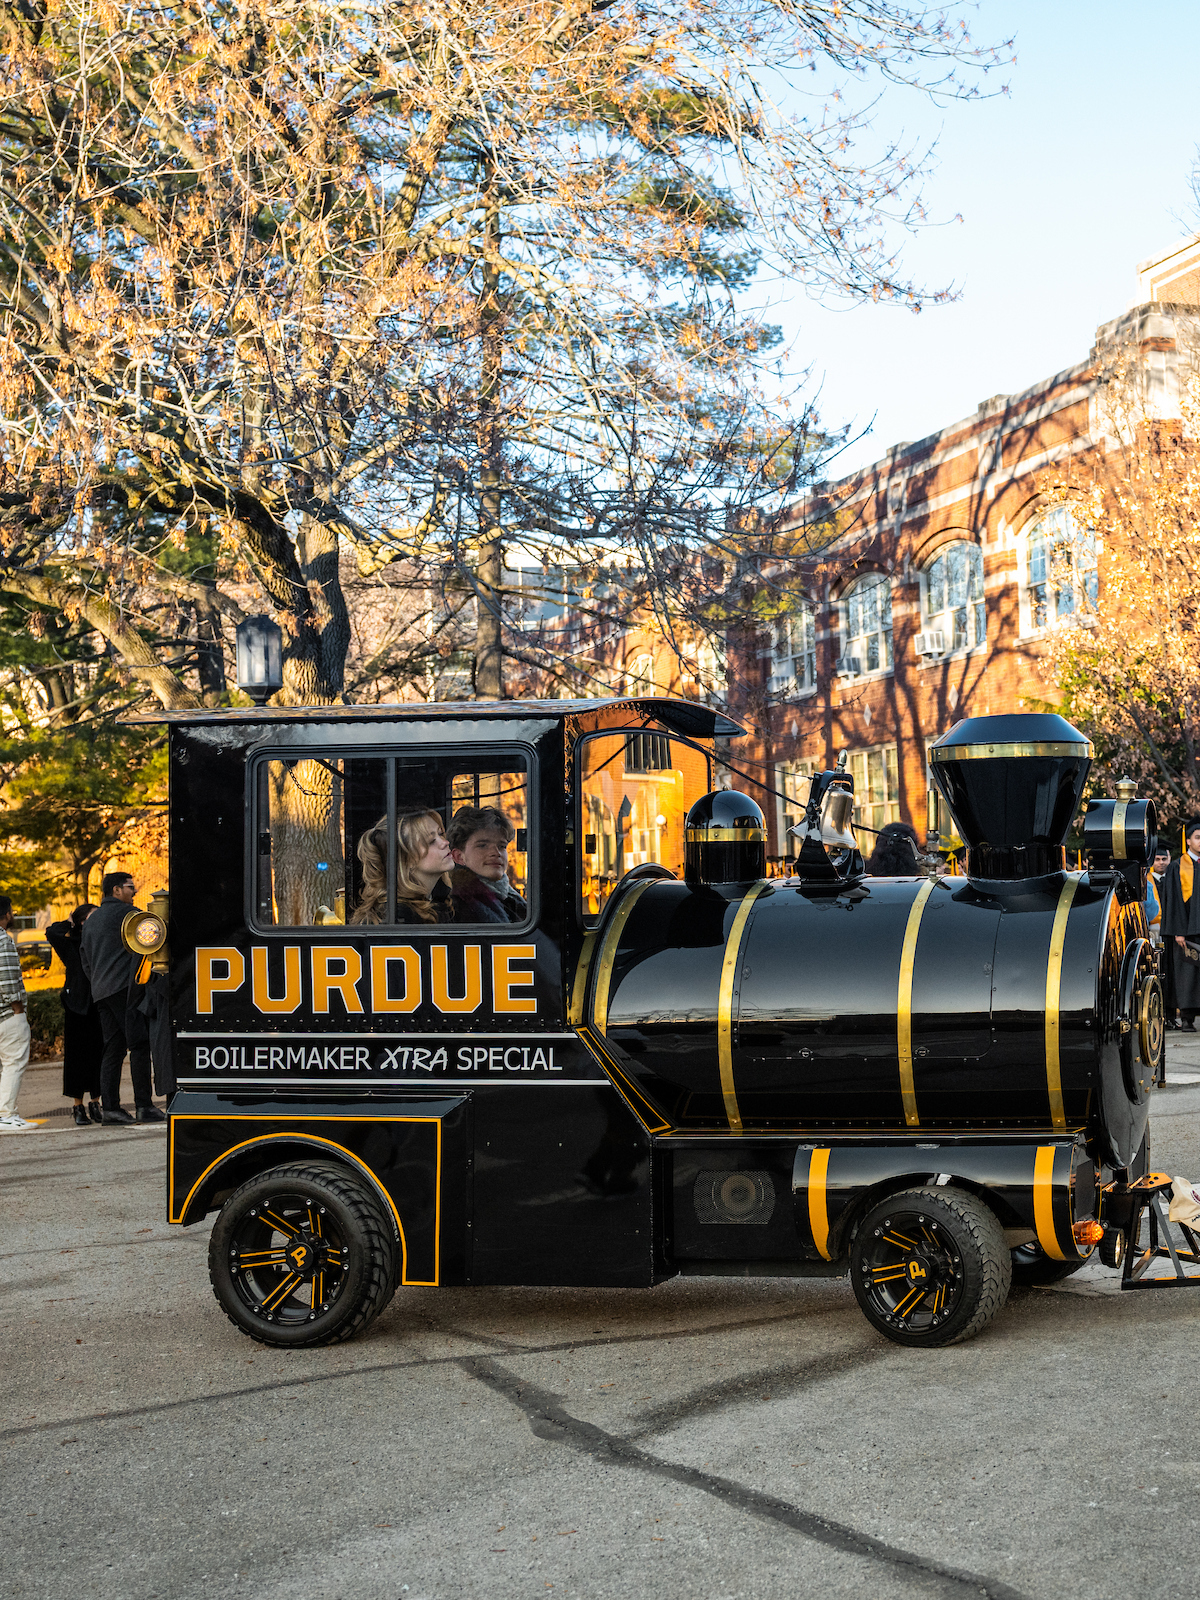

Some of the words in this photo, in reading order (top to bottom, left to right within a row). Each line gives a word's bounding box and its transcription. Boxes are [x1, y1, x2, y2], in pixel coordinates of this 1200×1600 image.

[195, 944, 538, 1015] PURDUE
[195, 1046, 371, 1071] BOILERMAKER
[379, 1046, 449, 1073] XTRA
[456, 1046, 563, 1072] SPECIAL
[290, 1246, 307, 1267] P
[909, 1261, 926, 1279] P
